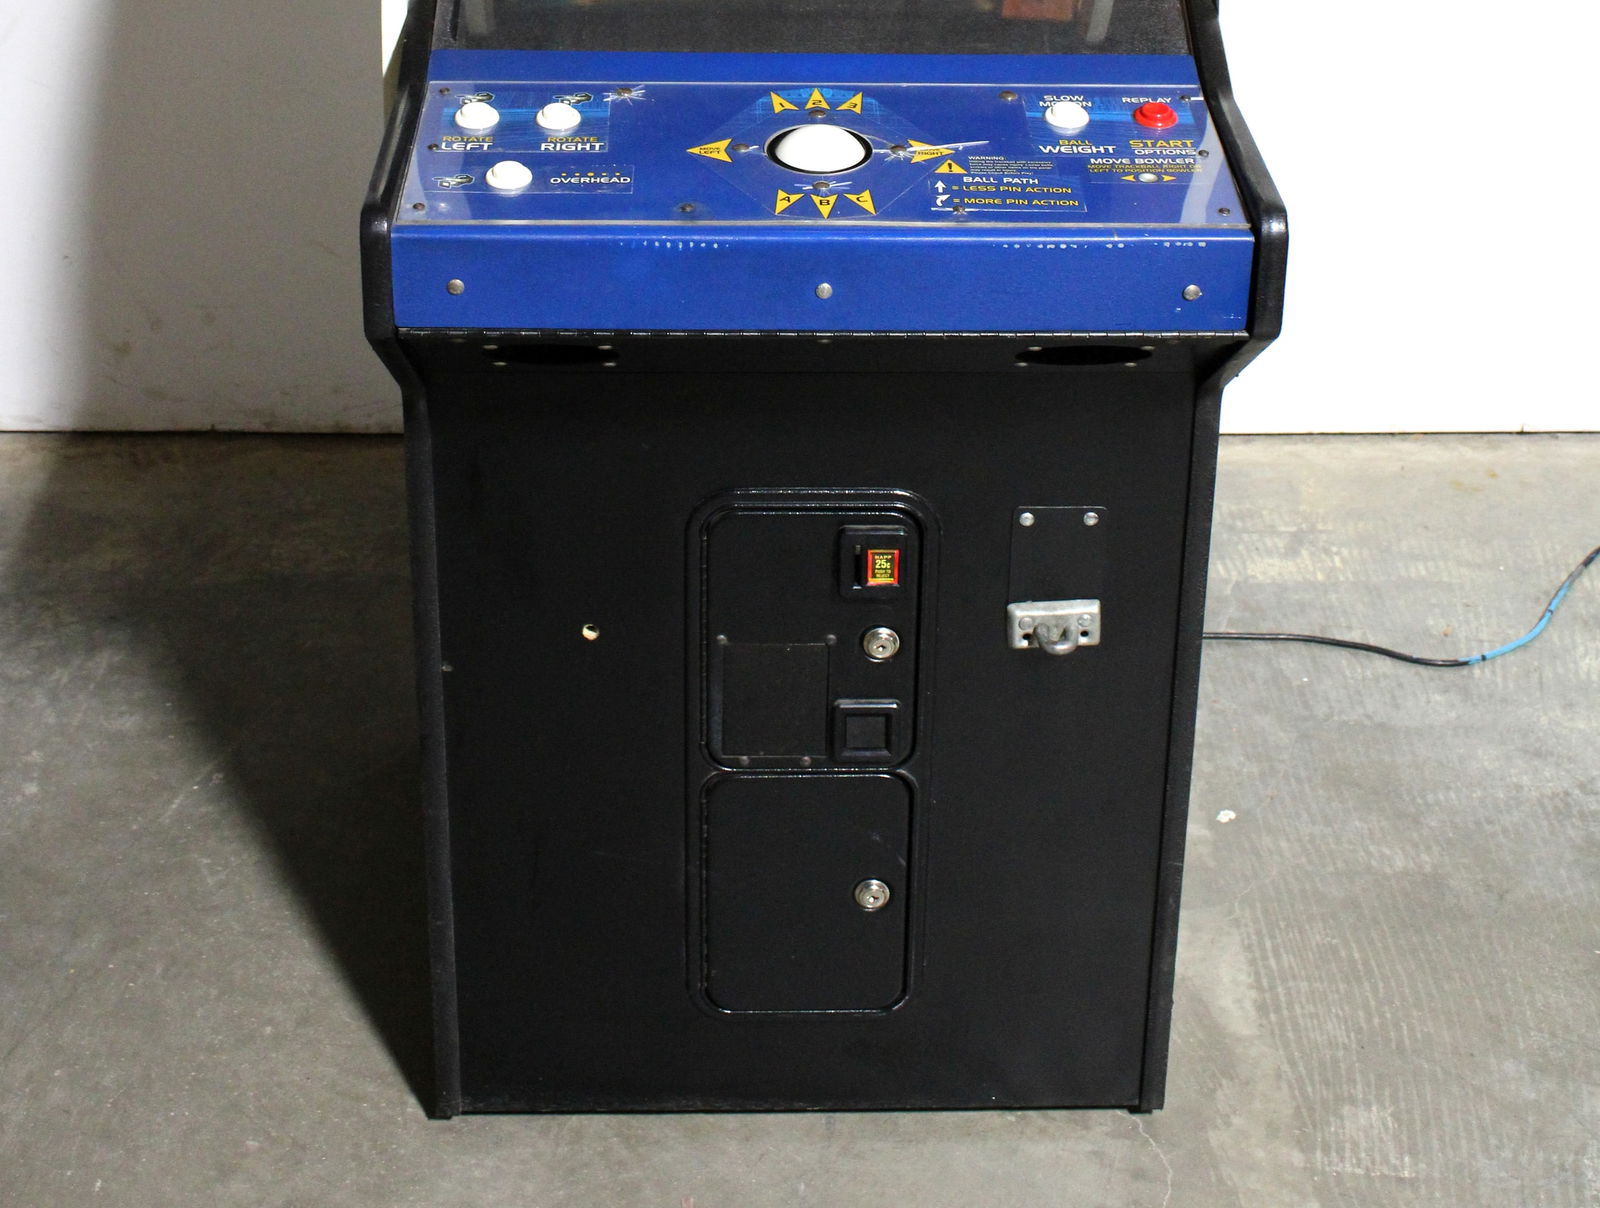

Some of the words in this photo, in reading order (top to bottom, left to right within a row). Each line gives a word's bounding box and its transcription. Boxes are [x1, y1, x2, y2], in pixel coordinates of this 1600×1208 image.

[1039, 100, 1092, 108] MOON
[441, 143, 493, 151] LEFT
[540, 143, 605, 151] RIGHT
[1129, 140, 1194, 148] START
[1039, 145, 1116, 154] WEIGHT
[550, 176, 631, 184] OVERHEAD
[819, 198, 830, 206] B
